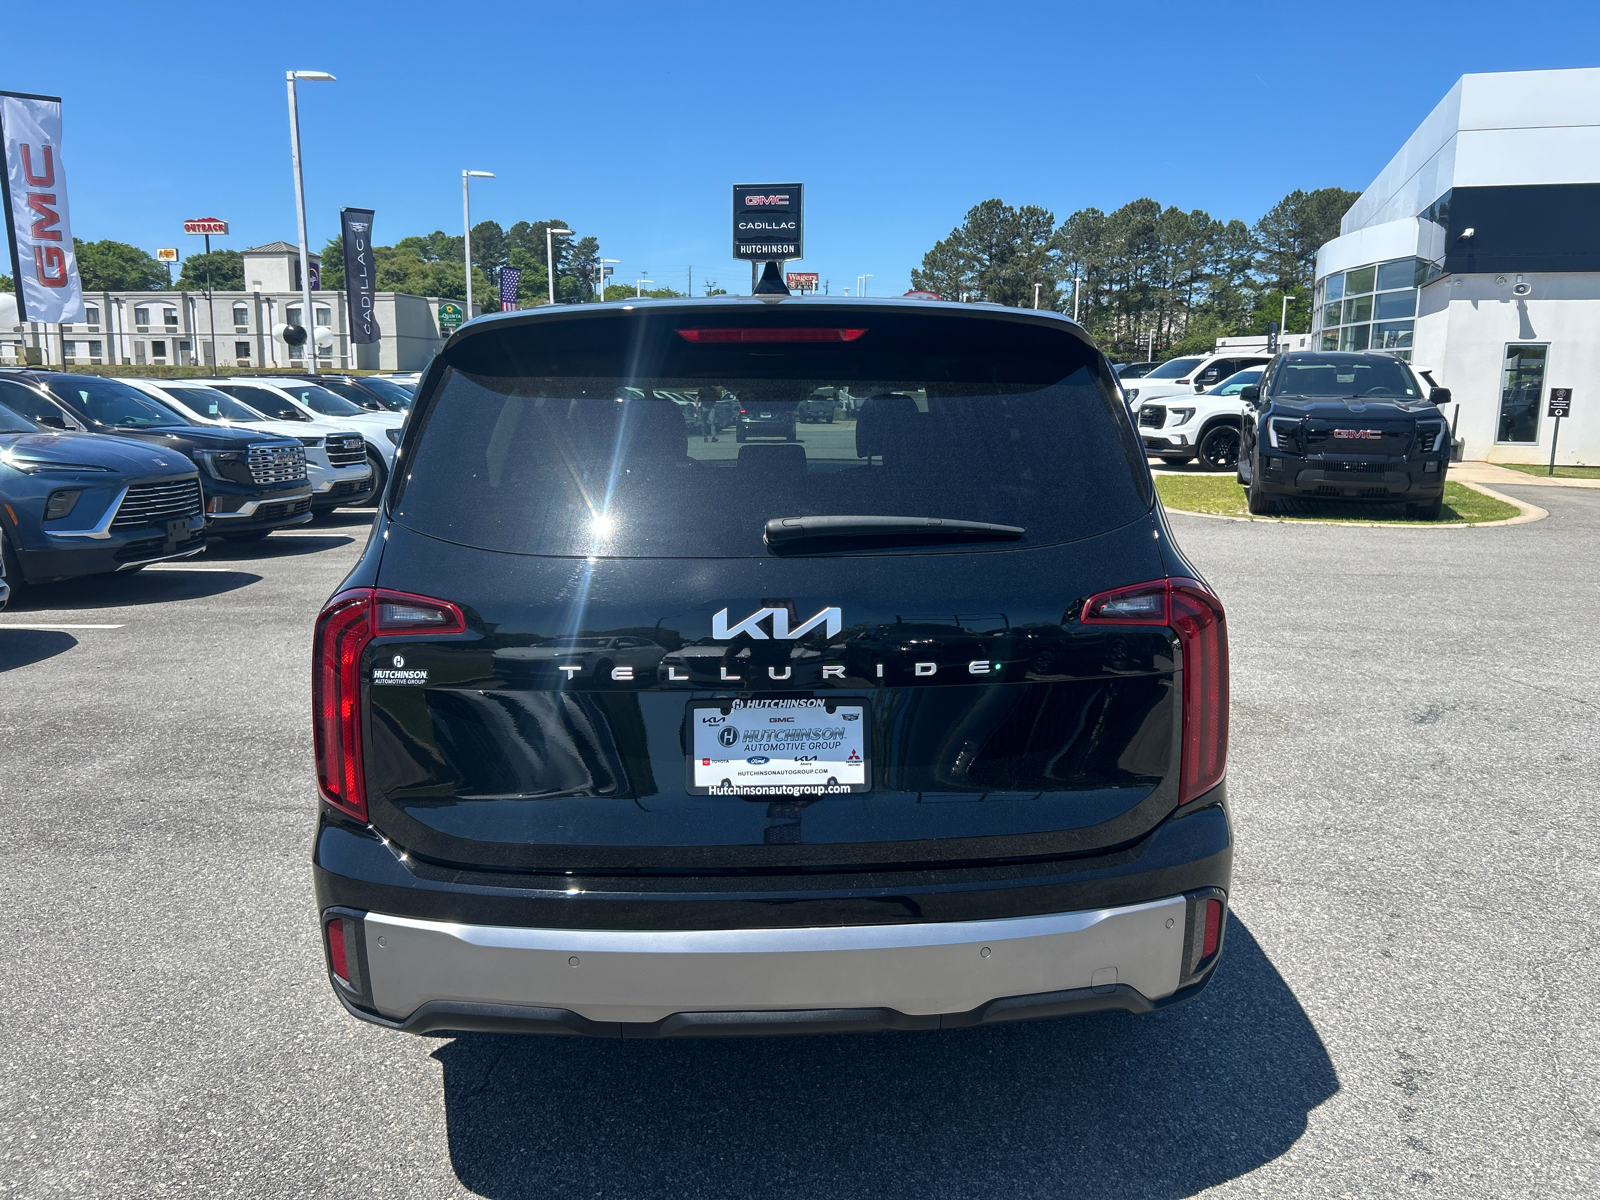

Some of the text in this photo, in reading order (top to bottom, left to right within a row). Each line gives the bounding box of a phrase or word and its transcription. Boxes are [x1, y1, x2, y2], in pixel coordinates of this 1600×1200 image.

[745, 195, 789, 205] GMC
[20, 143, 68, 288] GMC
[184, 224, 224, 232] OUTBACK
[741, 245, 794, 253] HUTCHINSON
[788, 274, 817, 282] Wagers
[356, 239, 371, 335] CADILLAC
[1334, 429, 1381, 439] GMC
[712, 607, 842, 640] KIA
[558, 660, 991, 681] TELLURIDE
[747, 699, 825, 709] HUTCHINSON
[742, 727, 845, 743] HUTCHINSON
[744, 741, 841, 752] AUTOMOTIVE GROUP
[737, 769, 828, 777] HUTCHINSONAUTOGROUP.COM
[708, 784, 851, 796] Hutchinsonautogroup.com
